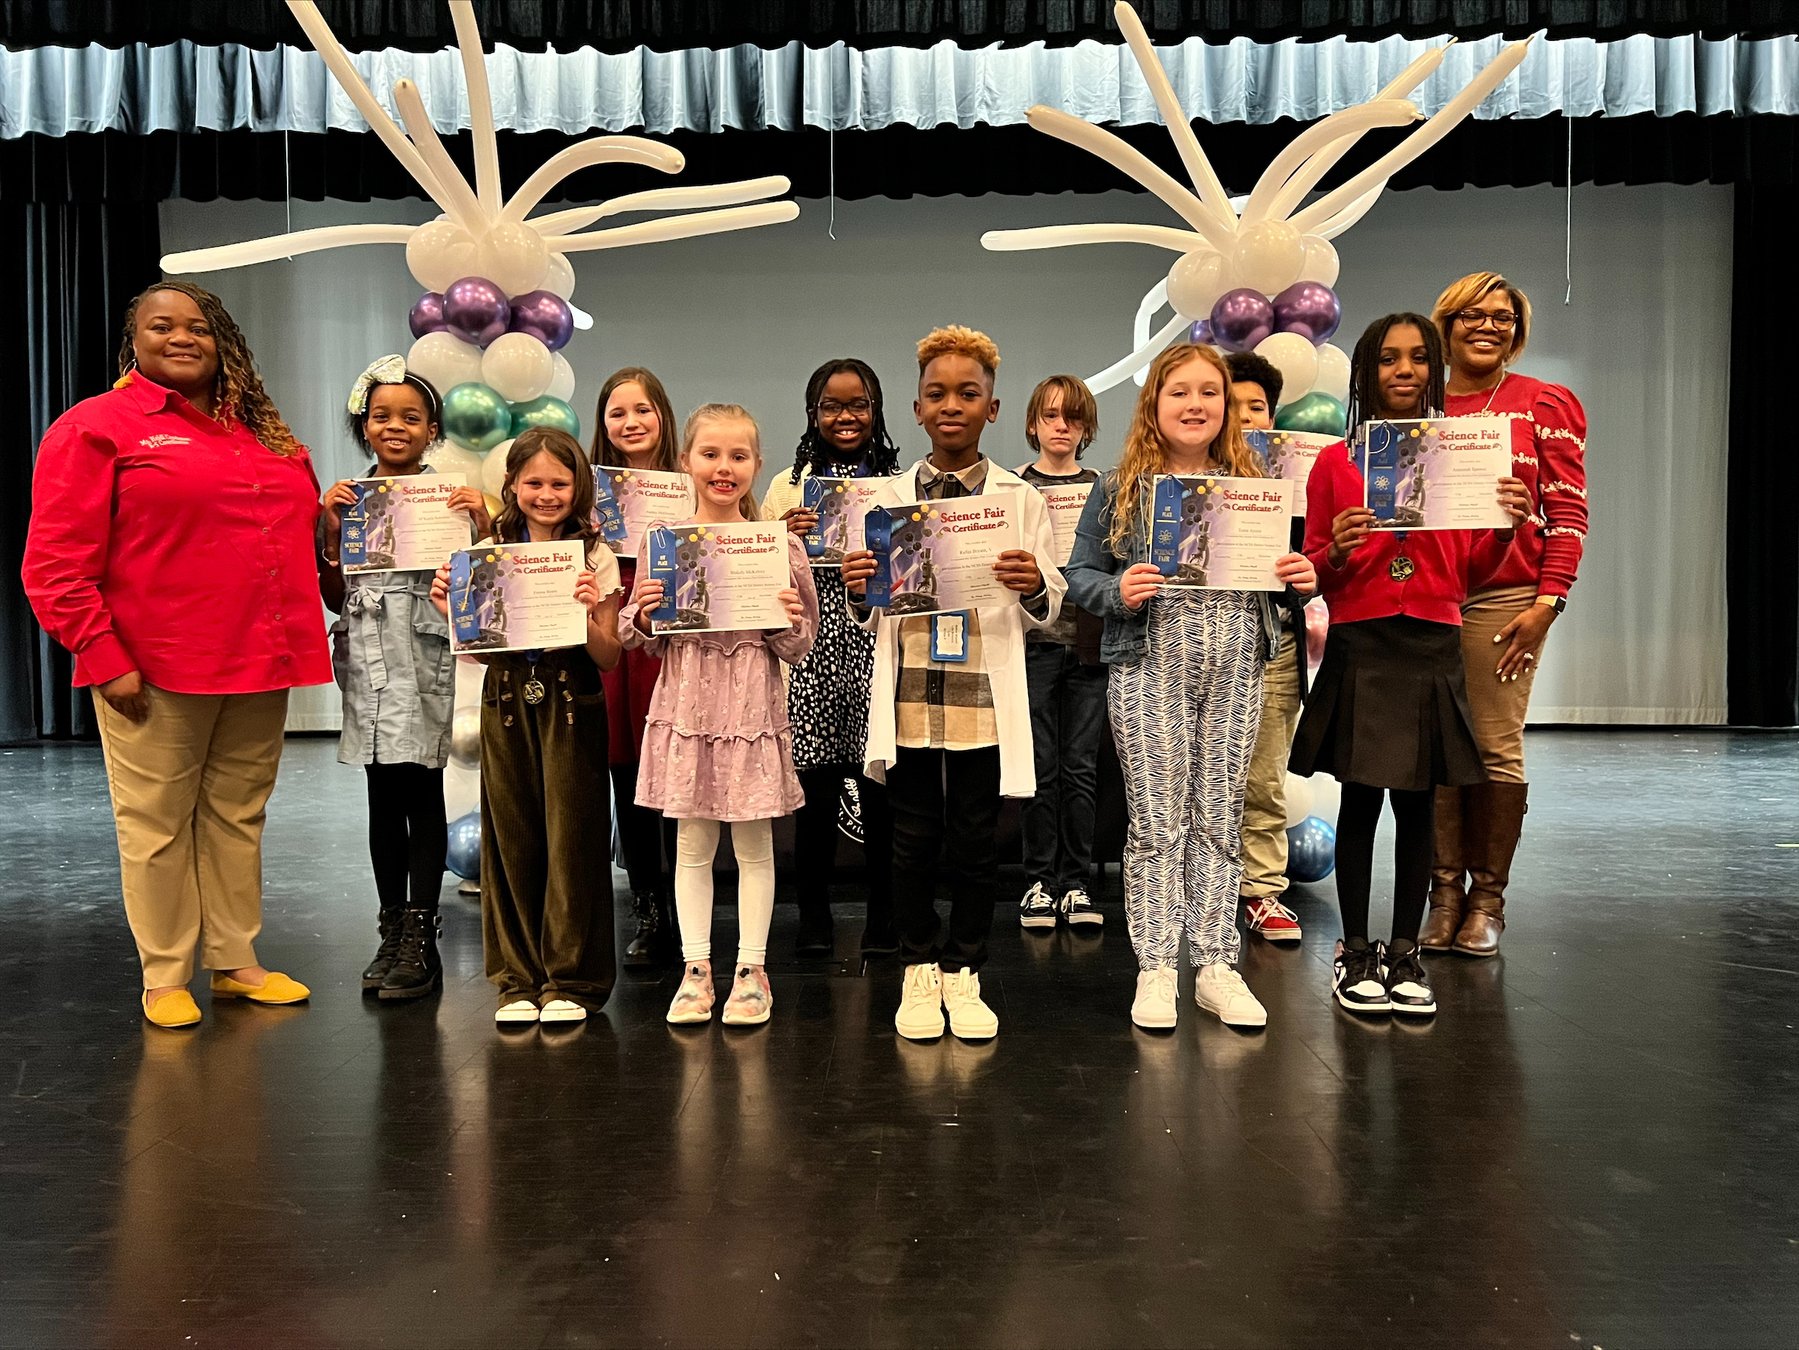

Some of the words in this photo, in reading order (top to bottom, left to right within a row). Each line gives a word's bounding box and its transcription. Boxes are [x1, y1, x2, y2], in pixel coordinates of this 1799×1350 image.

[1438, 430, 1478, 441] Science
[1480, 430, 1500, 440] Fair
[402, 486, 436, 495] Science
[439, 484, 456, 493] Fair
[637, 479, 668, 490] Science
[671, 482, 688, 491] Fair
[645, 490, 679, 499] Certificate
[1048, 495, 1076, 503] Science
[1223, 489, 1259, 501] Science
[1262, 492, 1282, 502] Fair
[1232, 503, 1271, 512] Certificate
[940, 511, 981, 523] Science
[984, 507, 1005, 518] Fair
[952, 523, 997, 533] Certificate
[716, 535, 754, 545] Science
[756, 534, 776, 543] Fair
[727, 546, 768, 554] Certificate
[513, 555, 550, 565] Science
[553, 552, 573, 562] Fair
[524, 565, 564, 574] Certificate
